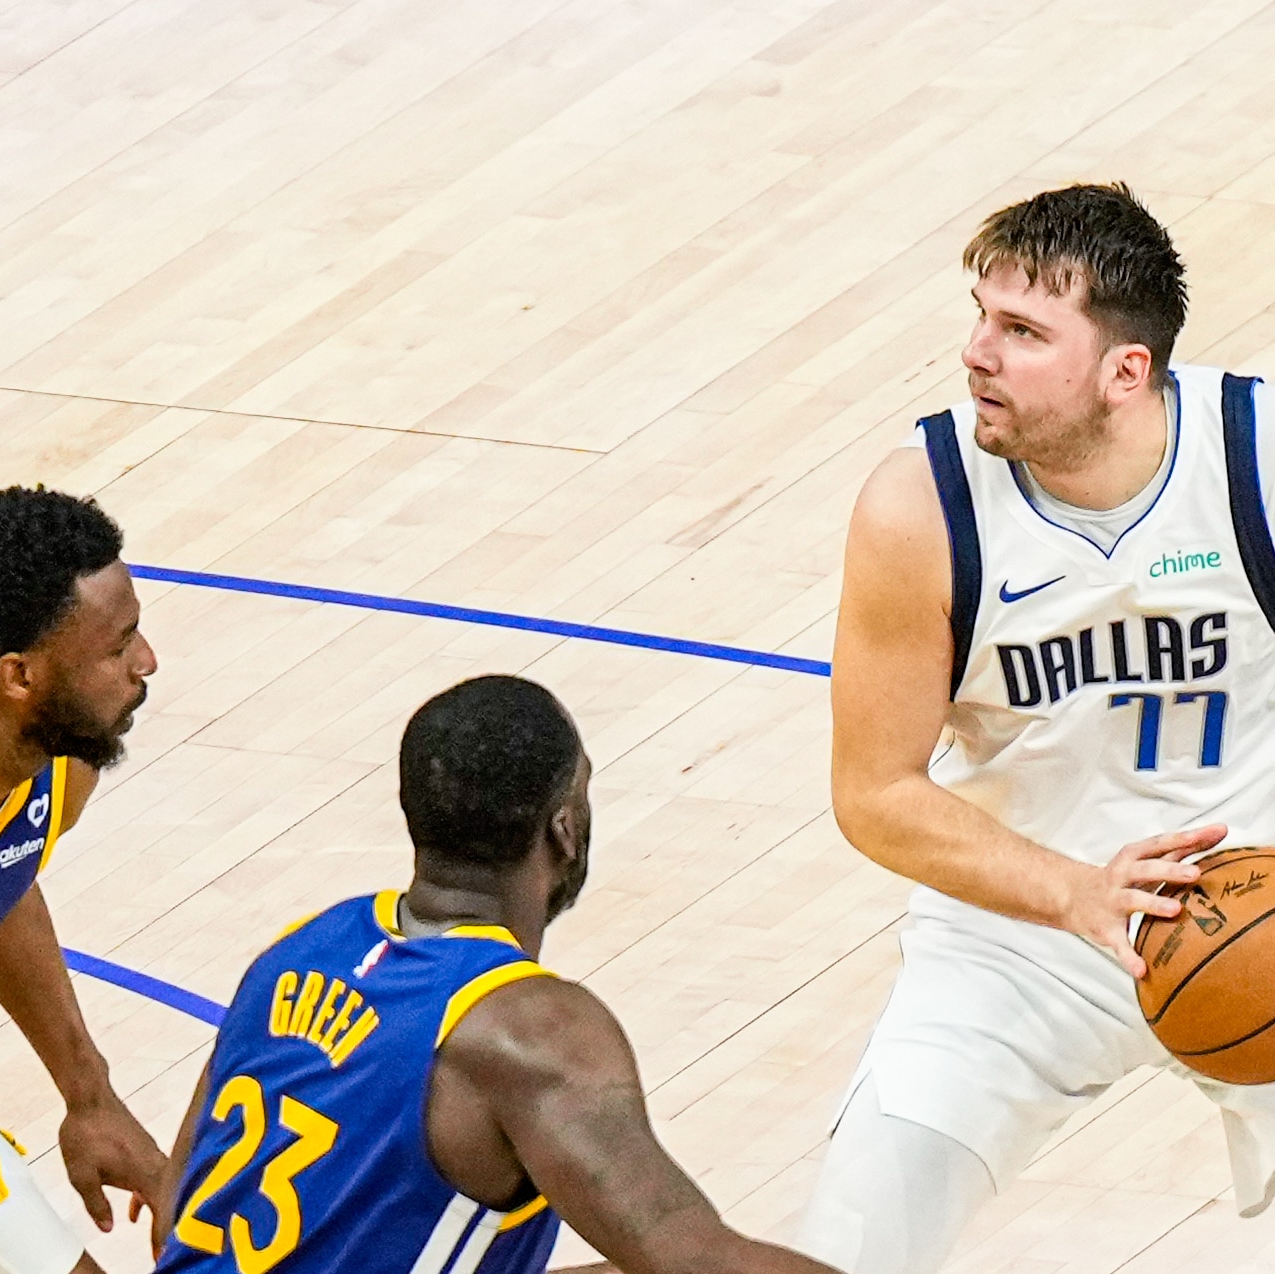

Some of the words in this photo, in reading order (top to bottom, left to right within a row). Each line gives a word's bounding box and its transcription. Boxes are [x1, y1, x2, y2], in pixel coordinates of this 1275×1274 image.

[1149, 549, 1222, 578] chime
[997, 612, 1229, 709] DALLAS
[1109, 691, 1230, 771] 77
[269, 969, 381, 1069] GREEN
